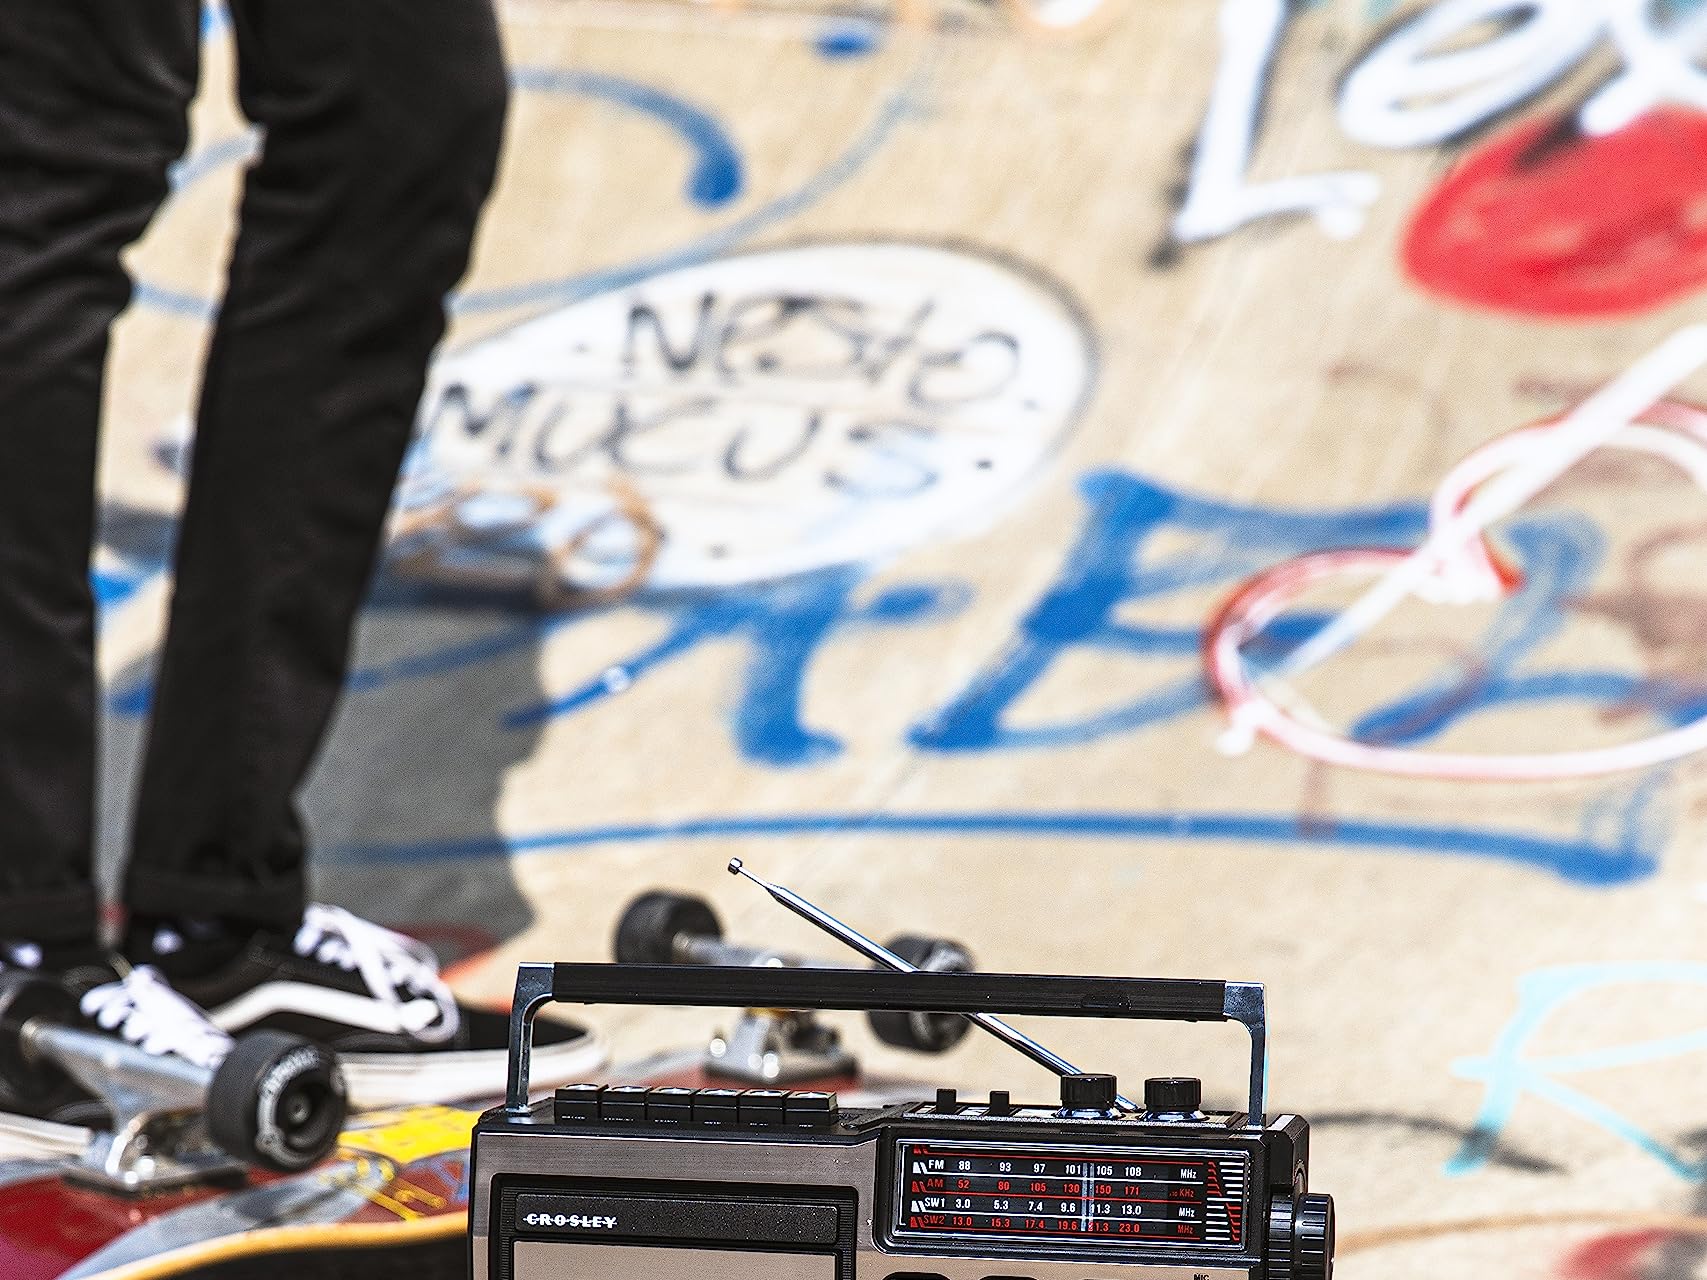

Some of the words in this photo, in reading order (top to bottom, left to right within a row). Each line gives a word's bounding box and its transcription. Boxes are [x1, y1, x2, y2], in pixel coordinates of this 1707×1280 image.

[928, 1159, 945, 1170] FM
[958, 1160, 971, 1171] 88
[999, 1162, 1012, 1172] 93
[1033, 1163, 1046, 1174] 97
[1065, 1164, 1081, 1175] 101
[1096, 1165, 1113, 1176] 105
[1125, 1166, 1142, 1177] 108
[1180, 1168, 1197, 1179] MHz
[927, 1178, 944, 1188] AM
[957, 1178, 971, 1189] 52
[998, 1180, 1010, 1191] 80
[1030, 1182, 1046, 1192] 105
[1063, 1183, 1080, 1194] 130
[1095, 1185, 1112, 1195] 150
[1124, 1186, 1140, 1196] 171
[1179, 1188, 1194, 1198] KHz
[924, 1197, 946, 1208] SW1
[955, 1198, 971, 1209] 3.0
[993, 1200, 1009, 1210] 5.3
[1028, 1201, 1043, 1212] 7.4
[1060, 1202, 1076, 1213] 9.6
[1090, 1203, 1111, 1214] 11.3
[1121, 1204, 1142, 1215] 13.0
[1178, 1207, 1195, 1217] MHz
[523, 1213, 617, 1229] CROSLEY
[923, 1214, 945, 1225] SW2
[952, 1216, 973, 1227] 13.0
[991, 1217, 1010, 1228] 15.3
[1025, 1219, 1045, 1229] 17.4
[1057, 1220, 1077, 1231] 19.6
[1119, 1222, 1140, 1233] 23.0
[1177, 1224, 1194, 1234] MHz
